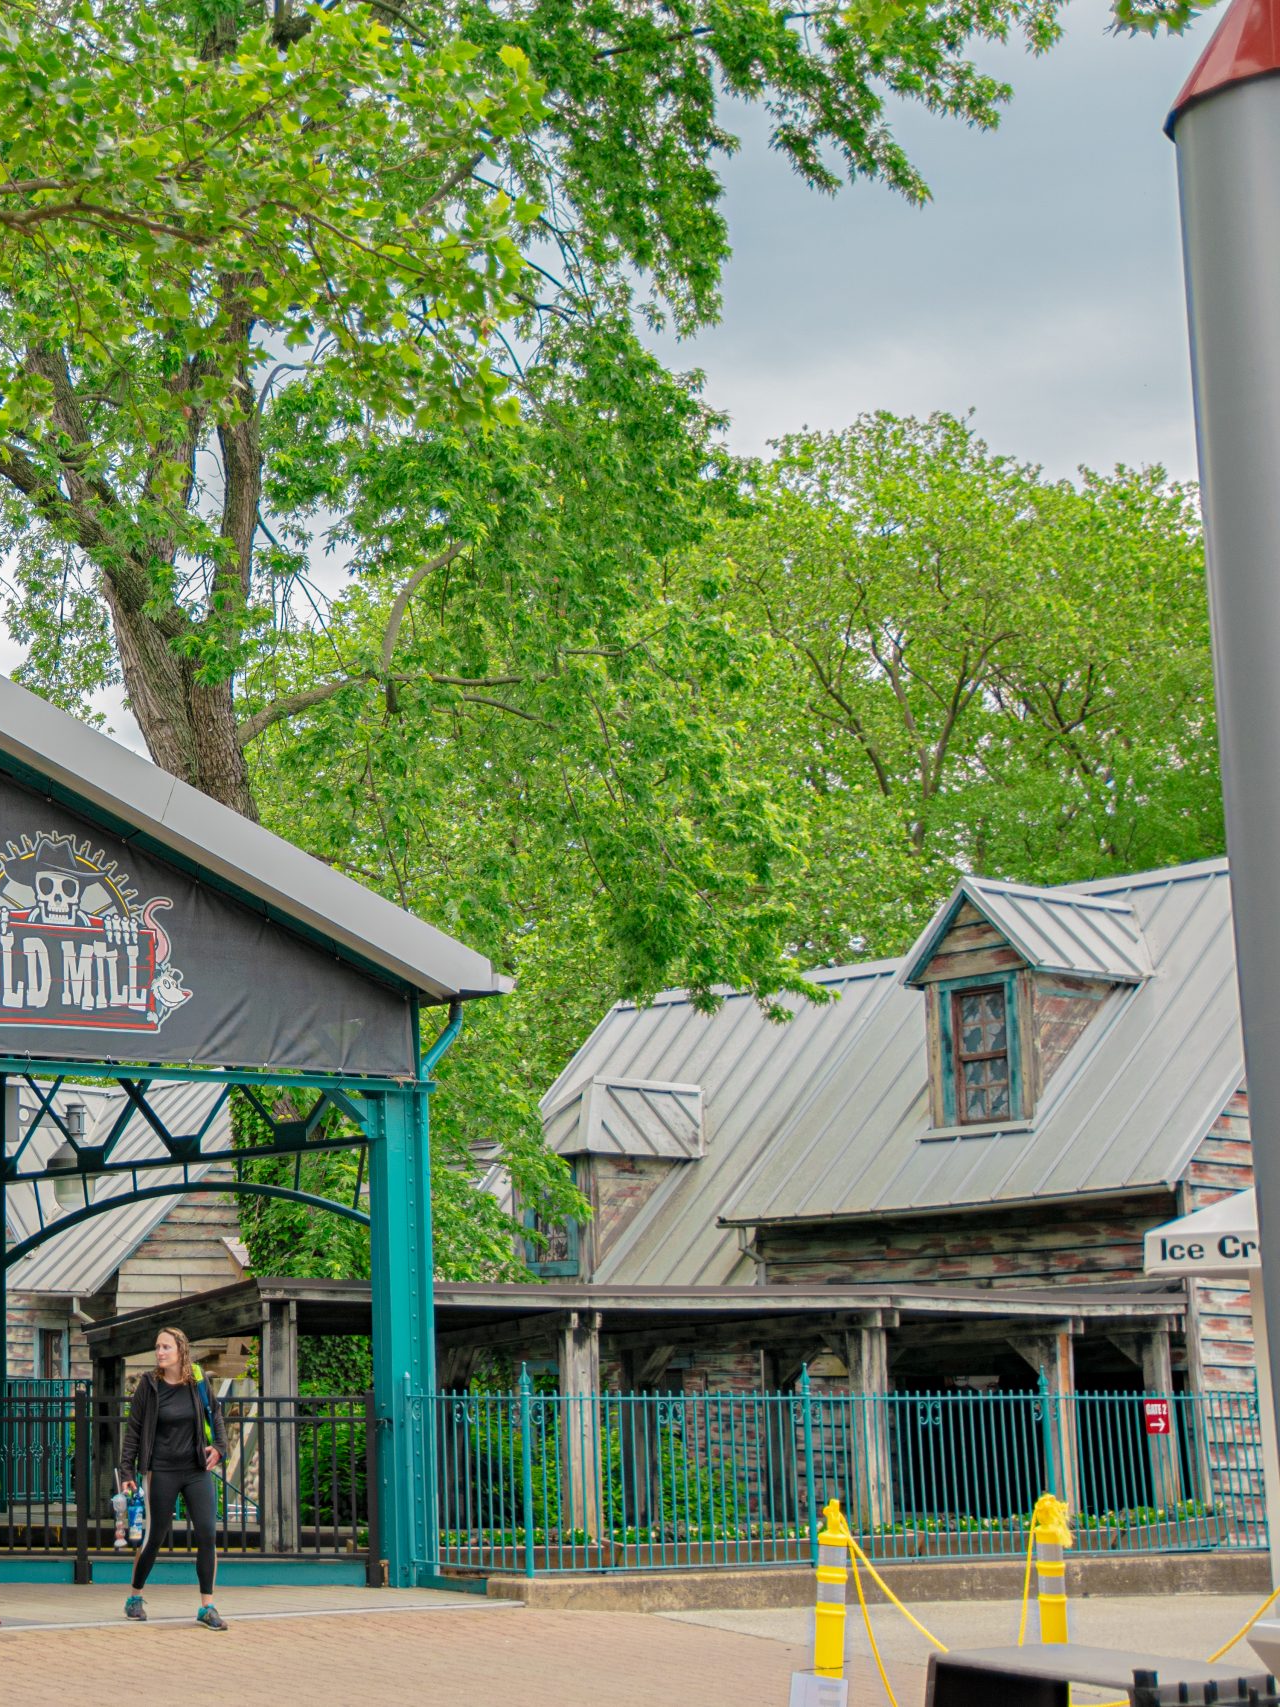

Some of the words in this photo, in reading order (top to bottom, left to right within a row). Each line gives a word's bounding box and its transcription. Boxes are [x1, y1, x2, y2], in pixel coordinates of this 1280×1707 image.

[60, 940, 148, 1012] MILL
[1160, 1237, 1205, 1261] Ice
[1217, 1234, 1259, 1259] Cr
[1145, 1403, 1162, 1415] GATE
[1161, 1403, 1168, 1415] 2
